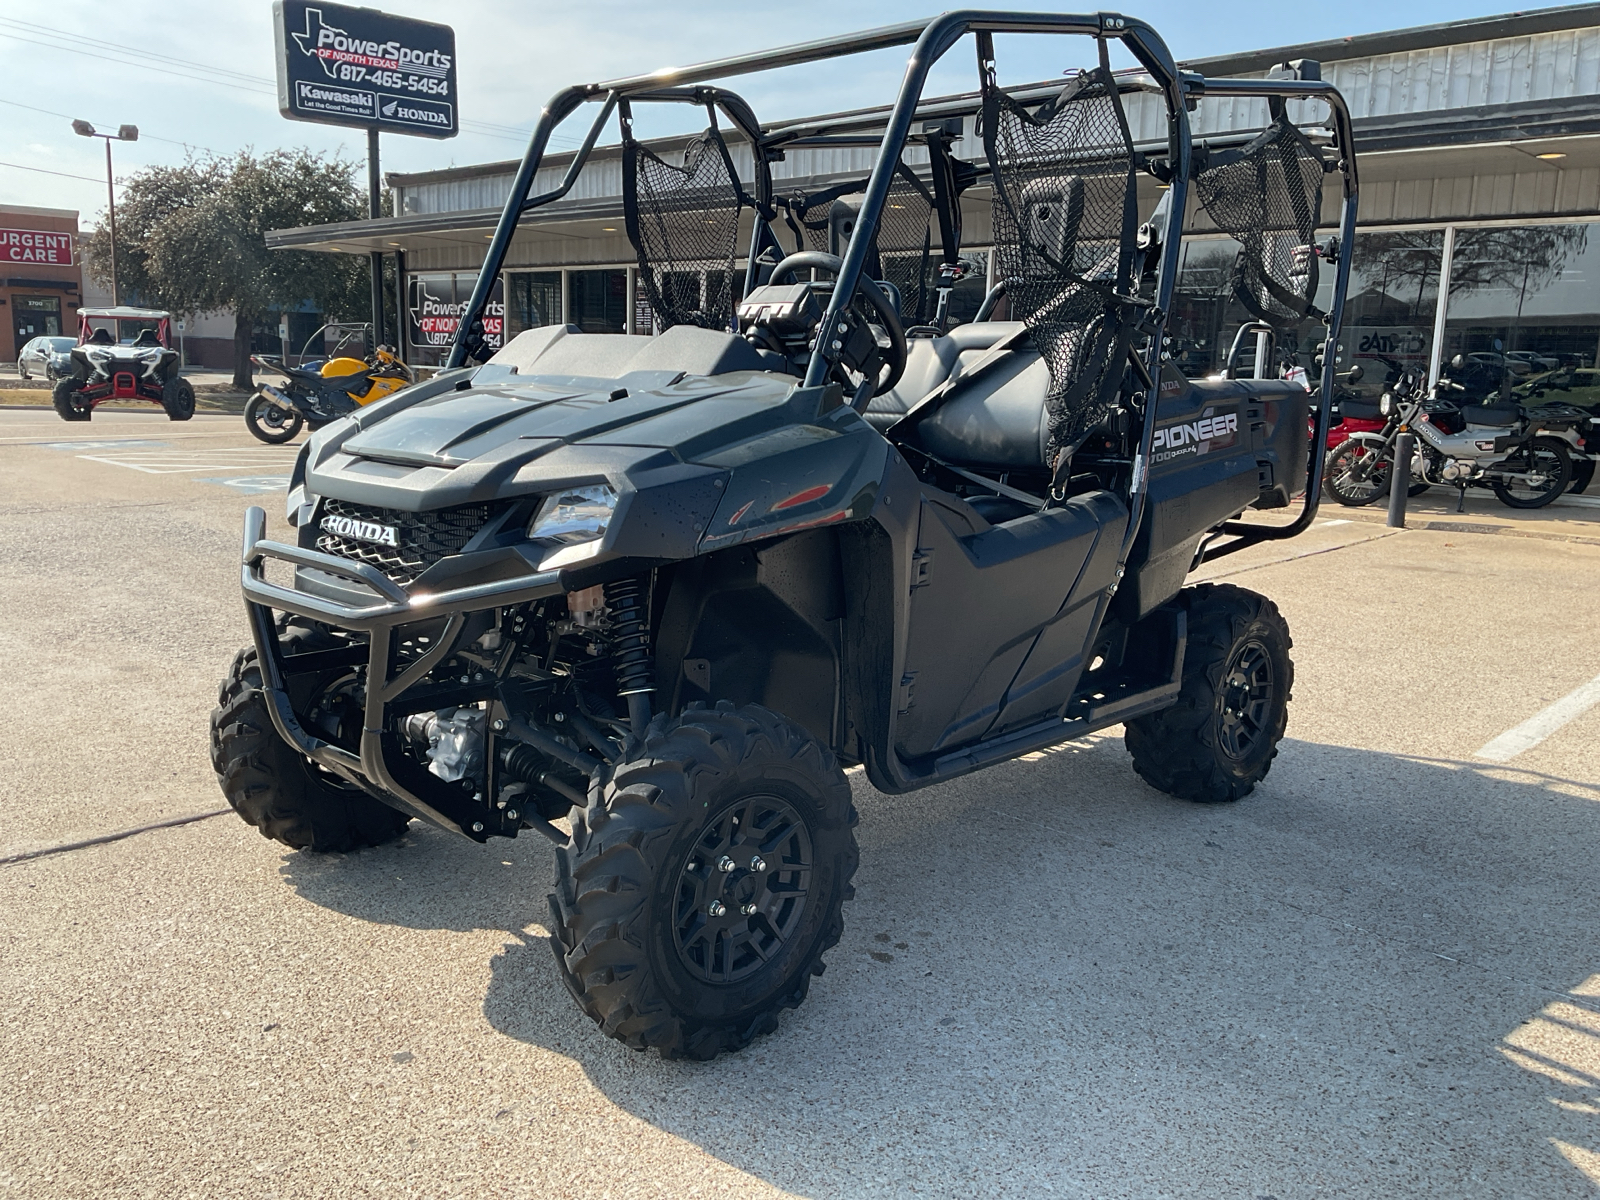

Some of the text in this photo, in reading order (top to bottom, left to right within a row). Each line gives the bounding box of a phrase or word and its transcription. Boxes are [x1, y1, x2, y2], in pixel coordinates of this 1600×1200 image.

[318, 29, 451, 69] PowerSports
[318, 49, 397, 70] OF NORTH TEXAS
[340, 64, 448, 96] 817-465-5454
[300, 84, 373, 107] Kawasaki
[325, 103, 340, 111] Good
[341, 105, 358, 113] Times
[397, 107, 448, 124] HONDA
[9, 247, 58, 262] CARE
[422, 318, 435, 331] OF
[1160, 380, 1180, 391] NDA
[1151, 413, 1238, 452] PIONEER
[1420, 424, 1442, 445] HONDA
[327, 515, 398, 547] HONDA
